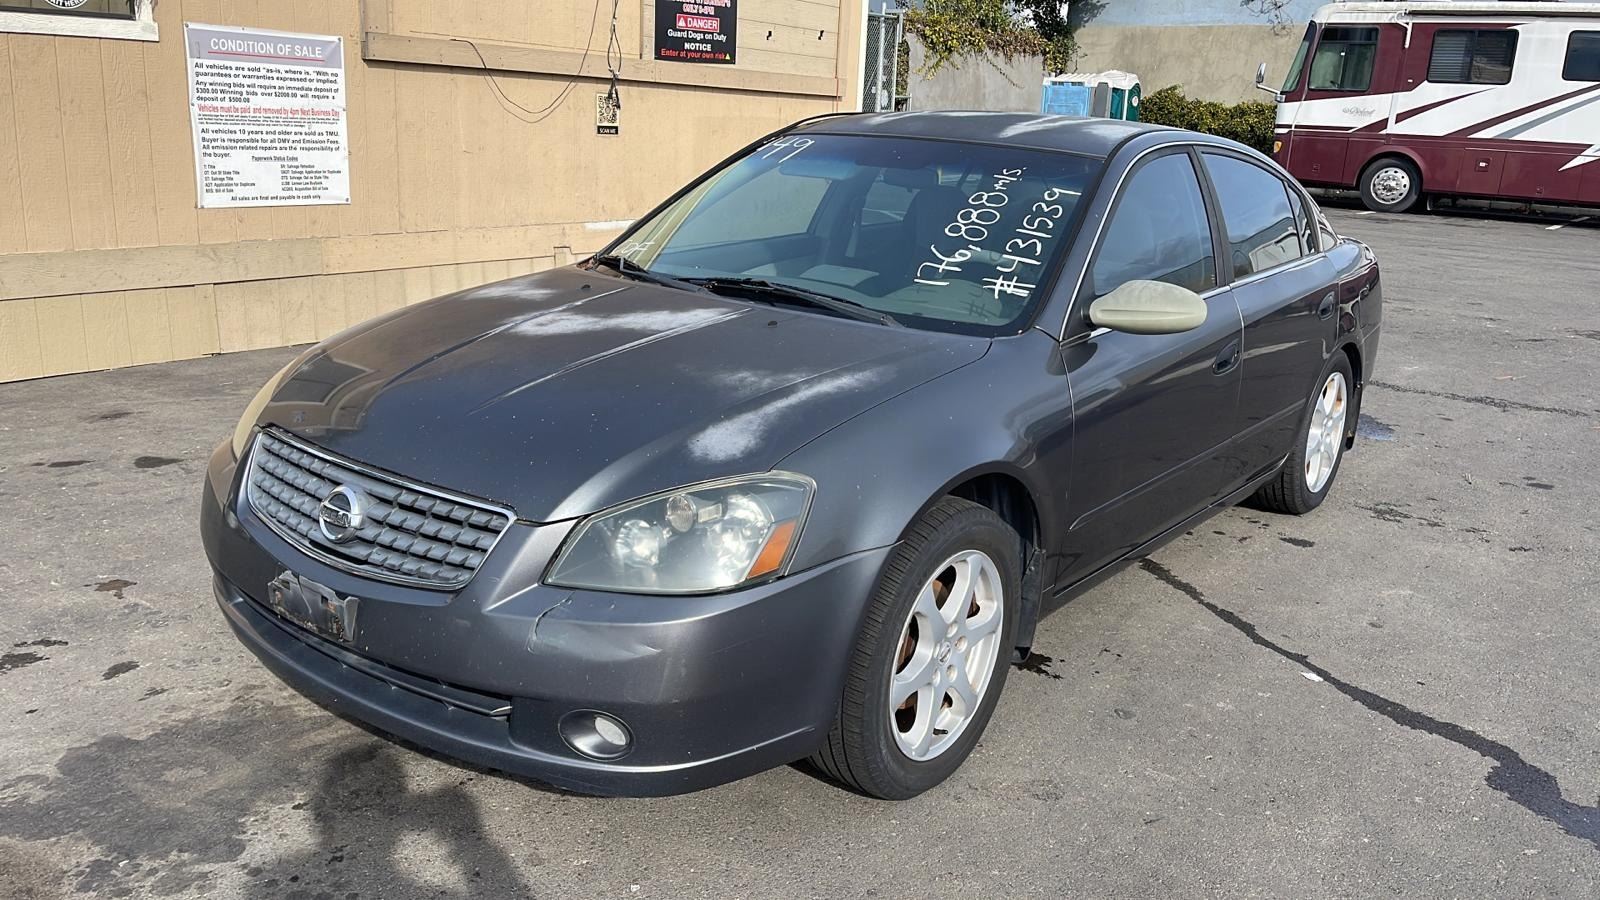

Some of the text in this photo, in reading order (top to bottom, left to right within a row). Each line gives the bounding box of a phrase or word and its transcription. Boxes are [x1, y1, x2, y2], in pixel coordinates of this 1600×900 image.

[687, 18, 718, 30] DANGER
[667, 29, 687, 38] Guard
[688, 32, 704, 41] Dogs
[714, 34, 727, 43] Duty
[210, 38, 322, 58] CONDITION OF SALE
[684, 43, 711, 51] NOTICE
[198, 104, 219, 113] Vehicles
[220, 106, 232, 114] must
[233, 106, 239, 114] be
[240, 106, 251, 115] paid
[282, 108, 289, 117] by
[290, 109, 300, 117] 4pm
[914, 192, 1009, 286] 176,888
[982, 187, 1082, 299] #431539
